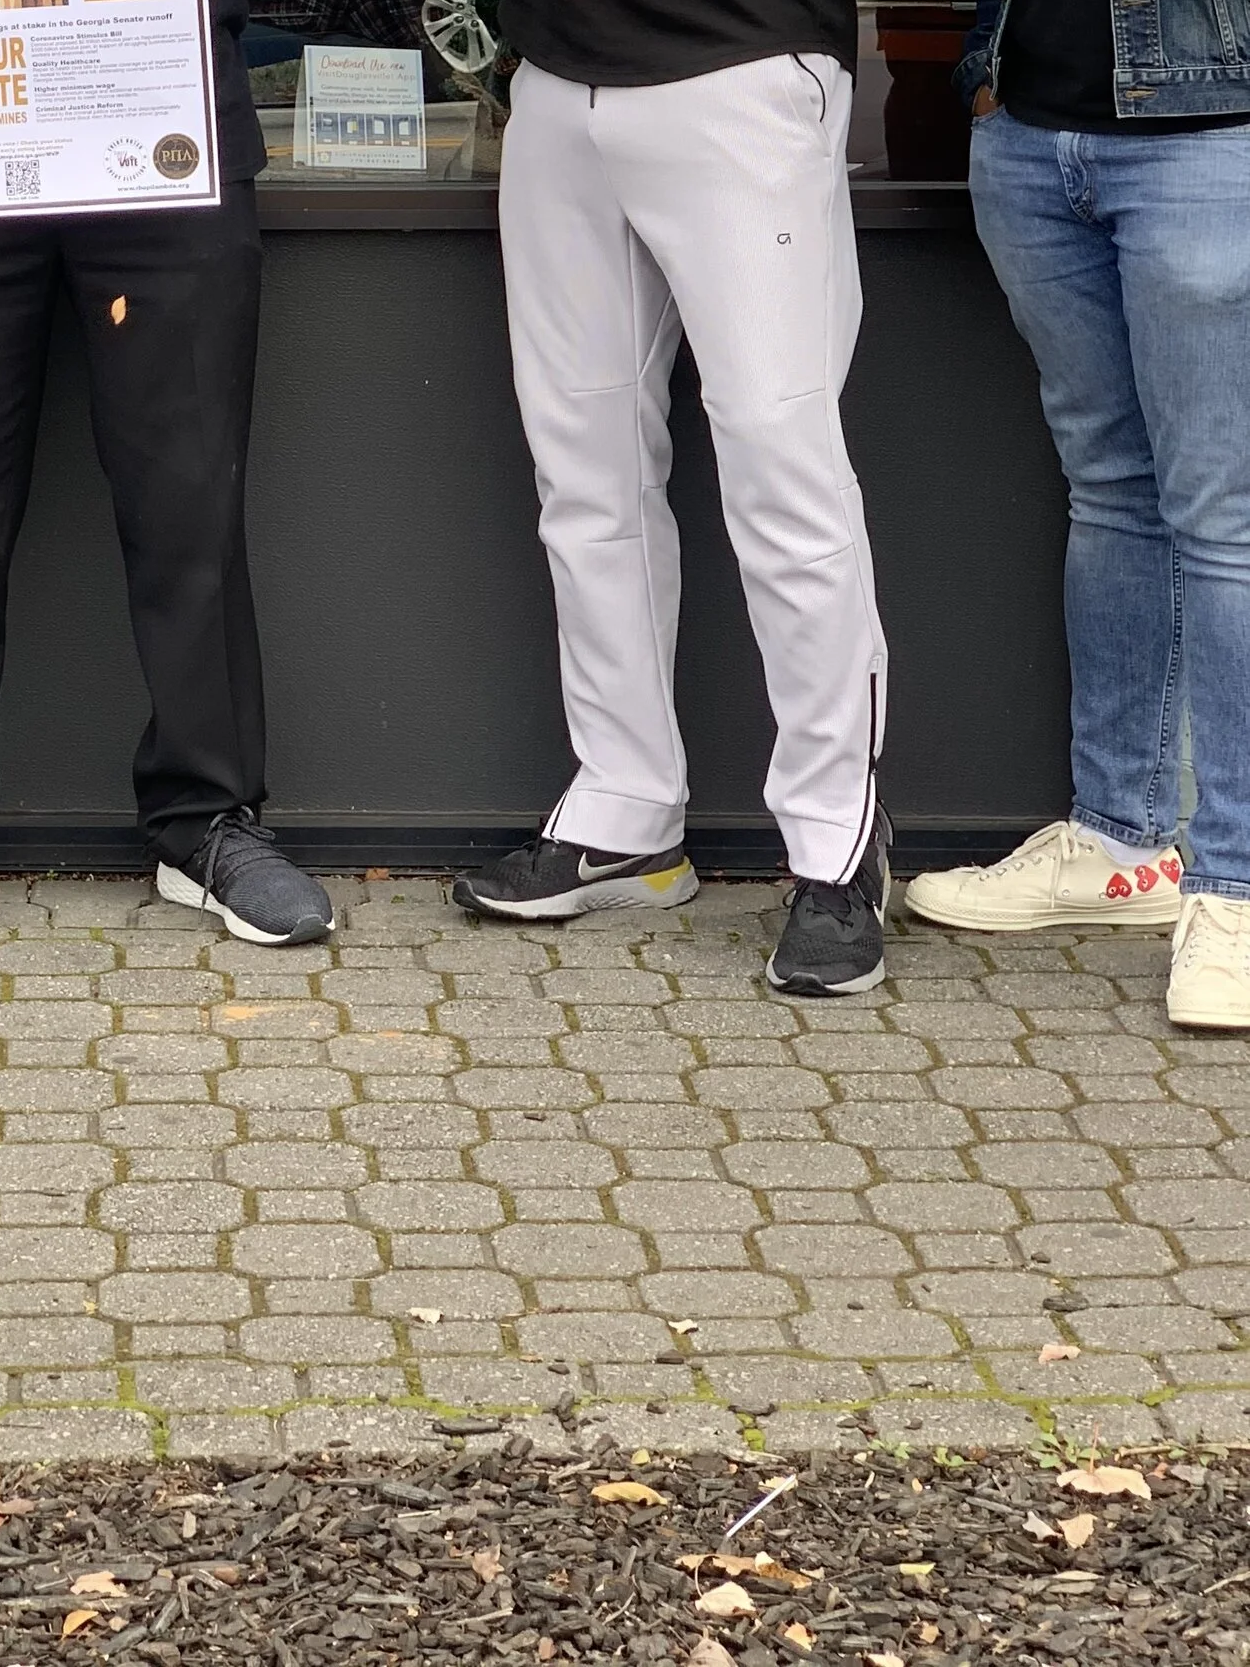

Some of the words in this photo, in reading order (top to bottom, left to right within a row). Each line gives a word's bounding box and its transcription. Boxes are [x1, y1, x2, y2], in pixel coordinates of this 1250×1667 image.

[22, 21, 46, 30] stake
[59, 19, 74, 27] the
[76, 17, 111, 28] Georgia
[113, 15, 144, 24] Senate
[146, 13, 173, 22] runoff
[30, 34, 75, 42] Coronavirus
[76, 32, 108, 40] Stimulus
[32, 60, 59, 69] Quality
[60, 58, 101, 66] Healthcare
[34, 86, 59, 94] Higher
[95, 83, 116, 91] wage
[35, 105, 67, 113] Criminal
[68, 103, 95, 111] Justice
[96, 101, 124, 109] Reform
